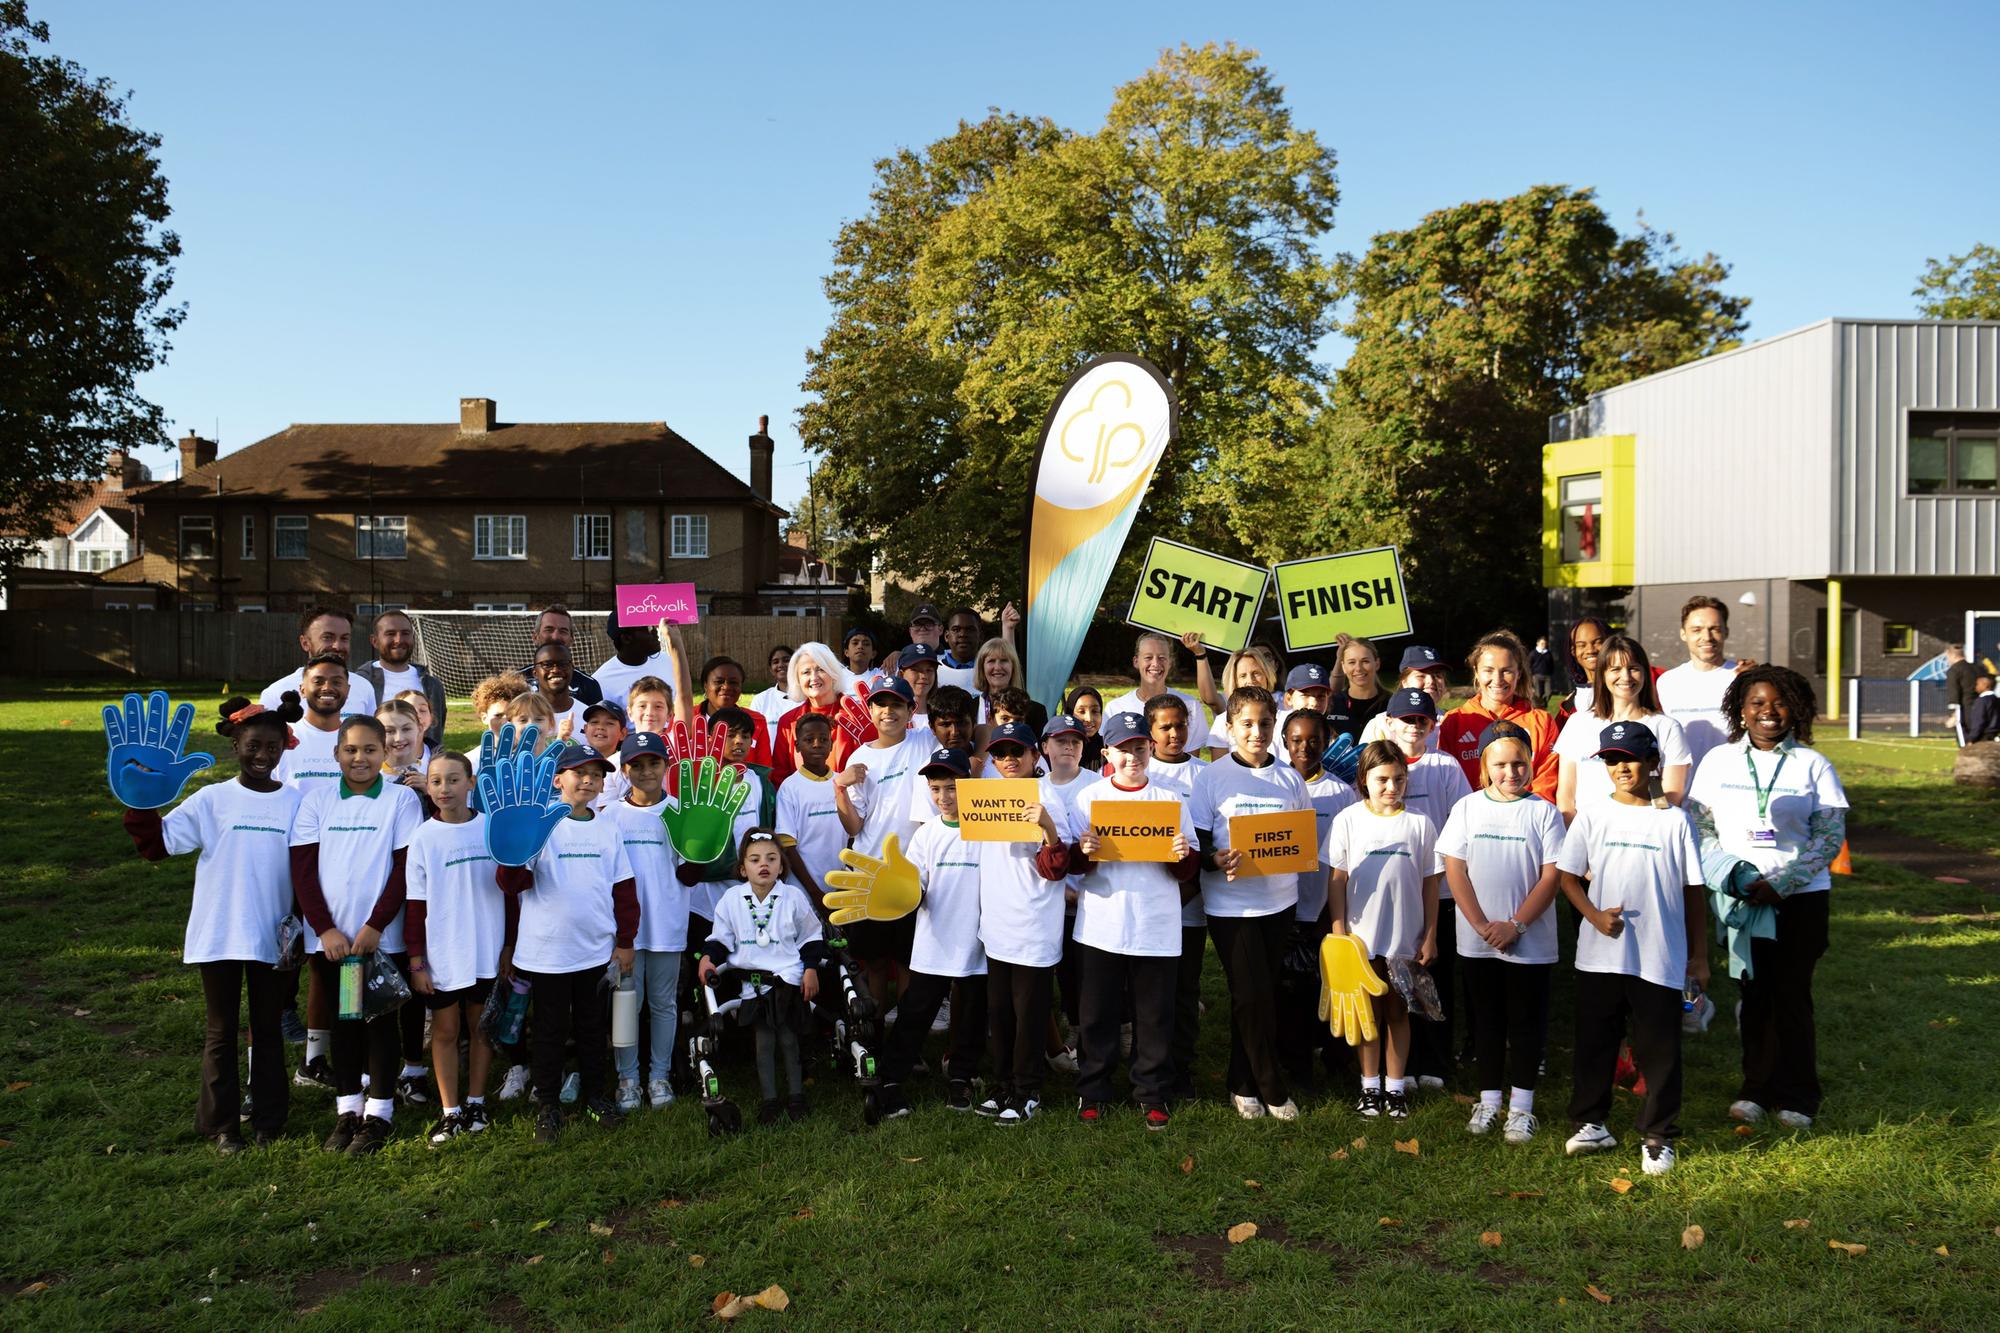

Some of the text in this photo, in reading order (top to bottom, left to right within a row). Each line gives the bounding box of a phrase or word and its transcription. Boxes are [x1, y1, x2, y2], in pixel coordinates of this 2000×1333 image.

[1145, 568, 1254, 624] START
[1287, 577, 1396, 619] FINISH
[626, 596, 689, 616] parkwalk
[294, 770, 328, 779] parkrun
[971, 799, 1026, 808] WANT TO
[962, 812, 1030, 822] VOLUNTEE
[261, 827, 286, 835] primary
[1095, 825, 1175, 837] WELCOME
[1255, 830, 1293, 843] FIRST
[1248, 845, 1300, 859] TIMERS
